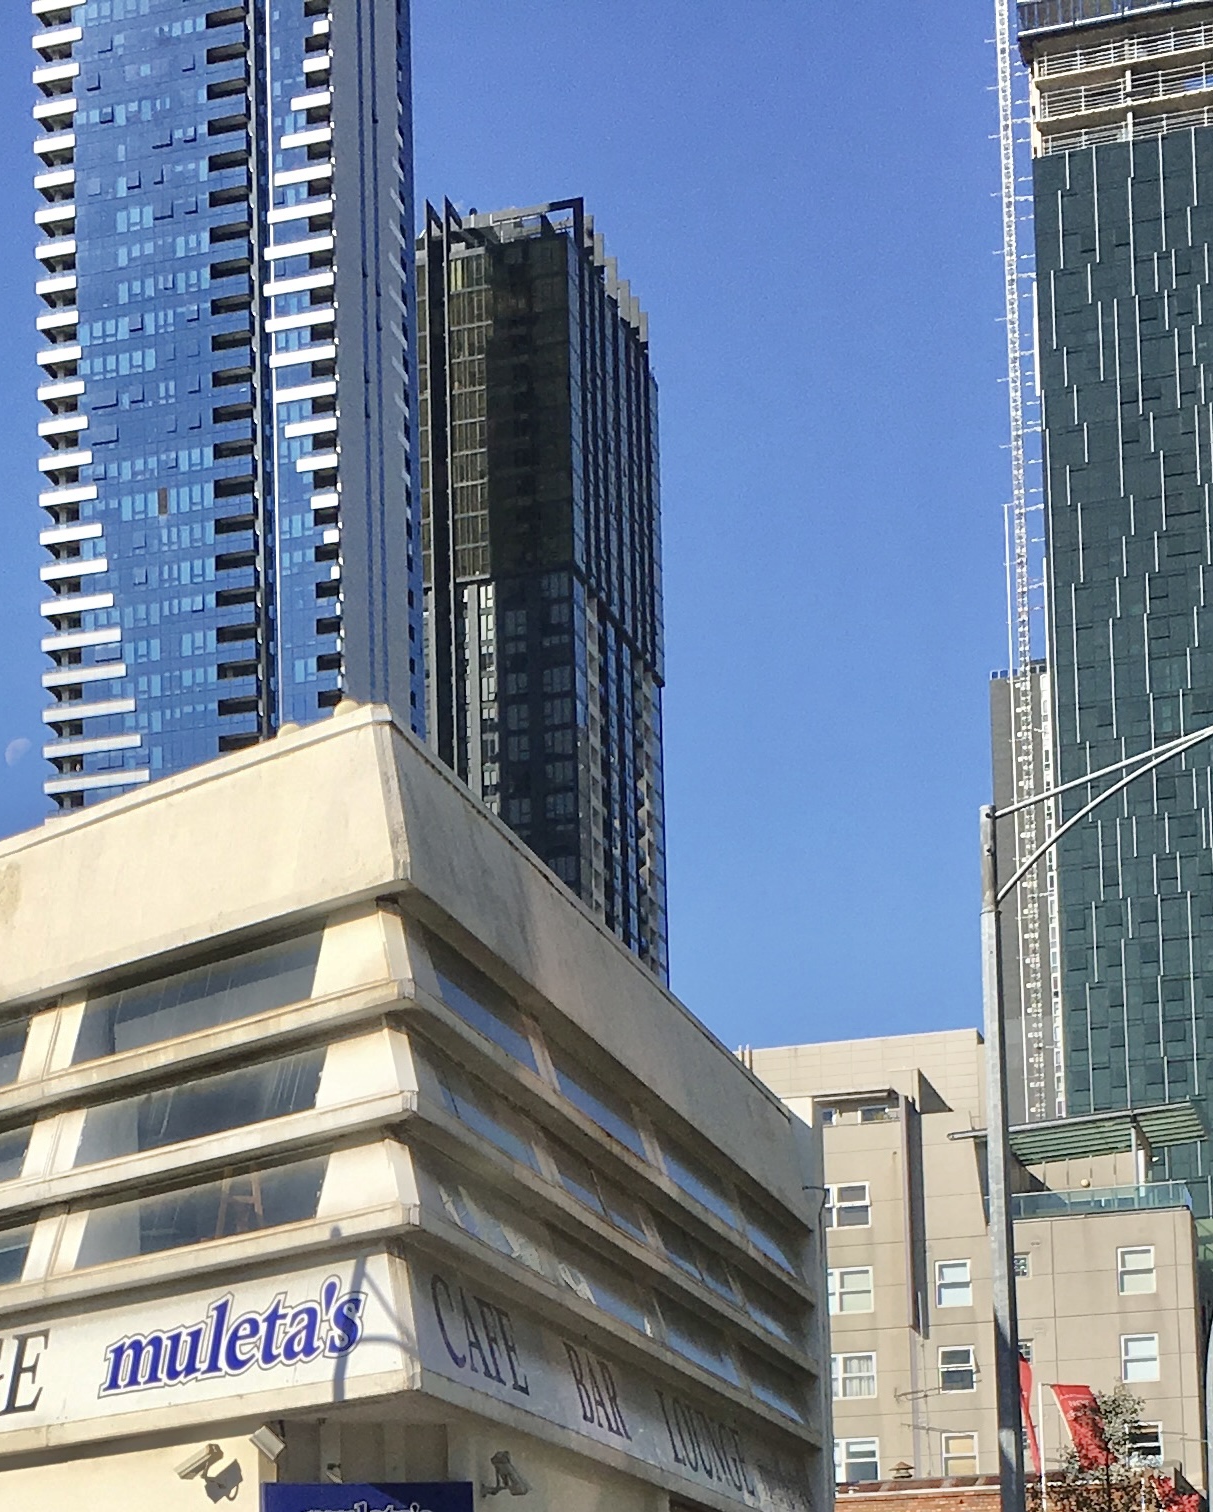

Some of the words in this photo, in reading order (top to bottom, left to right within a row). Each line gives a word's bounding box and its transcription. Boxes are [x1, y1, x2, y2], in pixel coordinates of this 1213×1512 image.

[99, 1277, 365, 1397] muleta's
[430, 1274, 530, 1397] CAFE
[562, 1341, 632, 1441] BAR
[655, 1388, 756, 1497] LOUNGE
